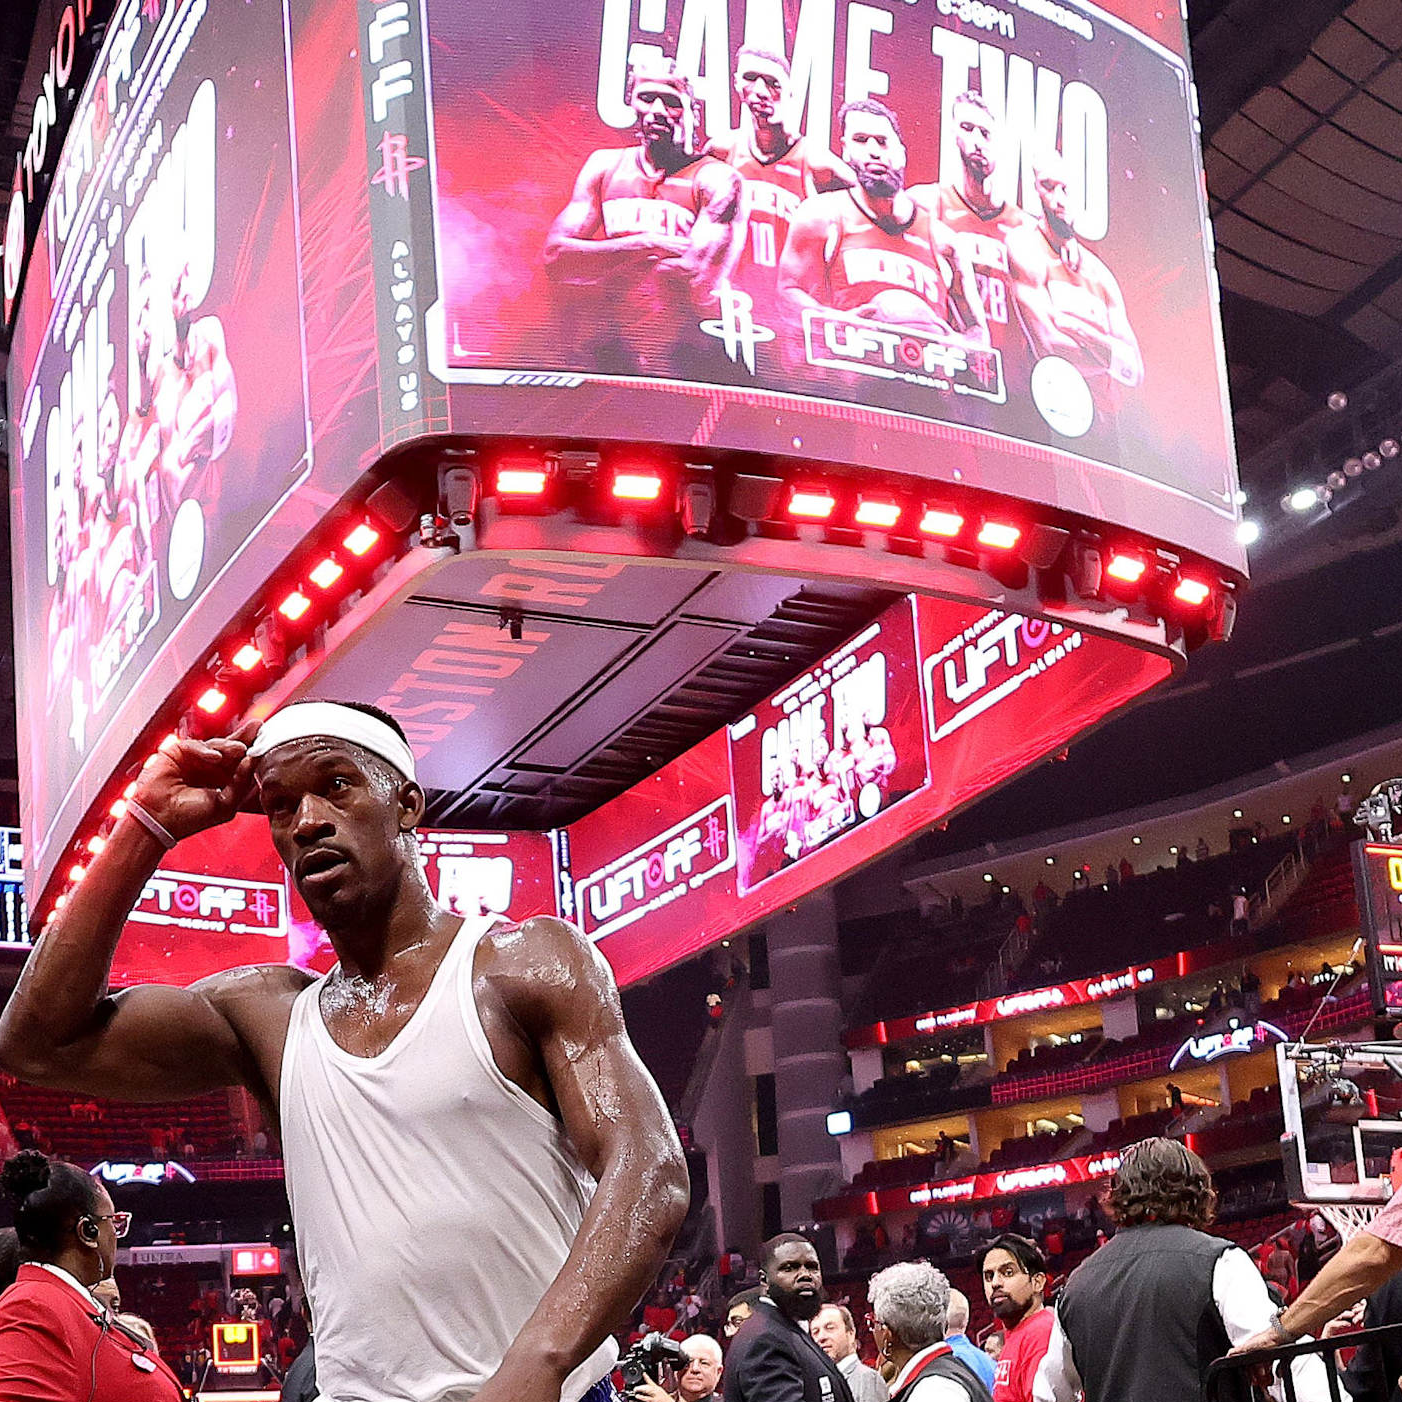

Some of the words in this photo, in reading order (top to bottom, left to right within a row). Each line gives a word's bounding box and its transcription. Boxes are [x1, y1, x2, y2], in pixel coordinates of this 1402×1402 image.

[596, 0, 894, 168] GAME
[932, 25, 1110, 241] TWO
[390, 239, 417, 365] ALWAYS
[399, 371, 419, 412] US
